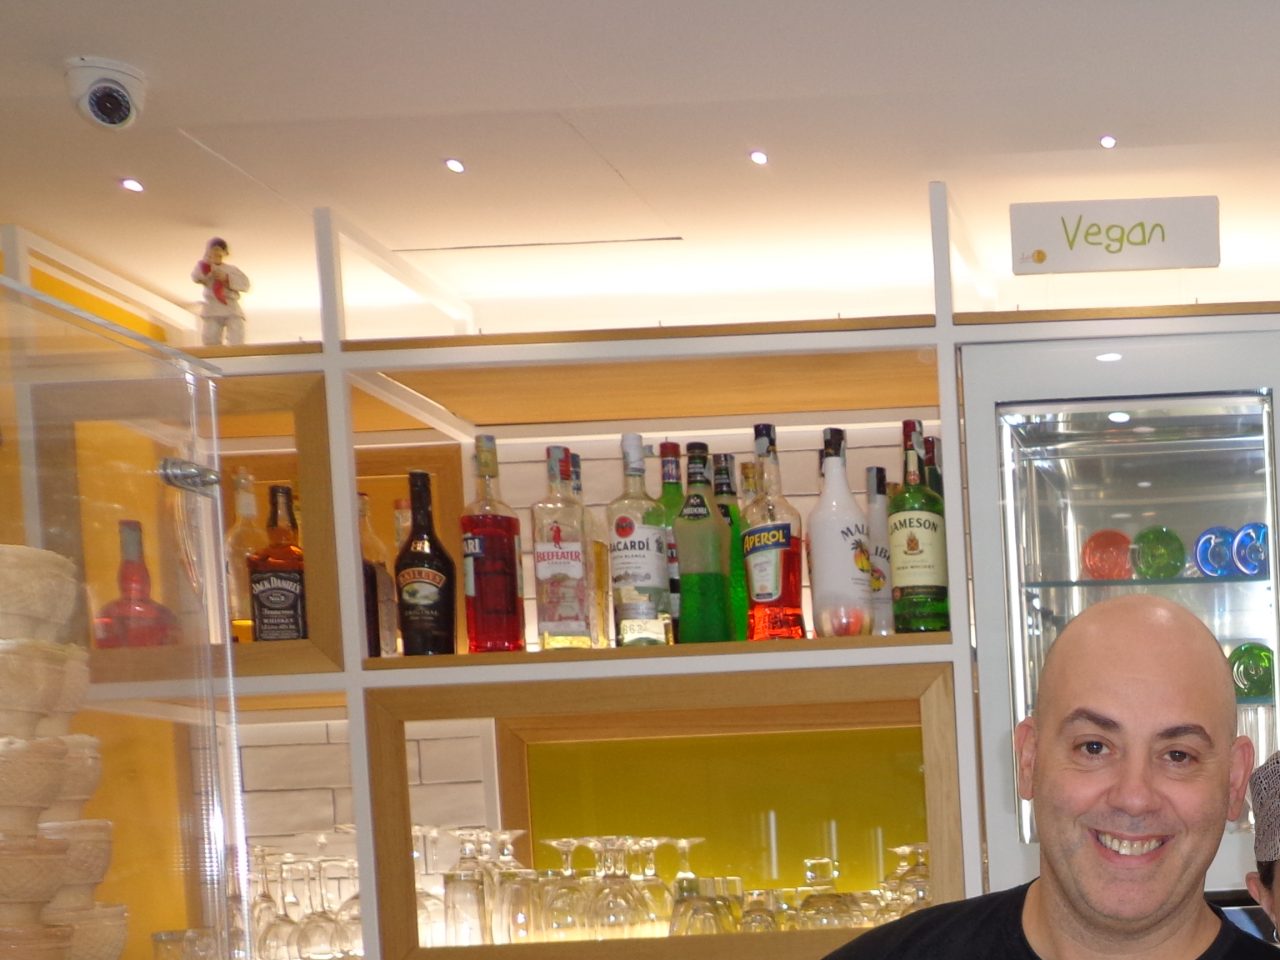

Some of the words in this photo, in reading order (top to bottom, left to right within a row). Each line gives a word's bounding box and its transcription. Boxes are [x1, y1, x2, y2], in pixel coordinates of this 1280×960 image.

[1061, 214, 1166, 254] Vegan
[889, 517, 939, 536] JAMESON
[743, 529, 786, 552] APEROL
[536, 550, 582, 562] BEEFEATER
